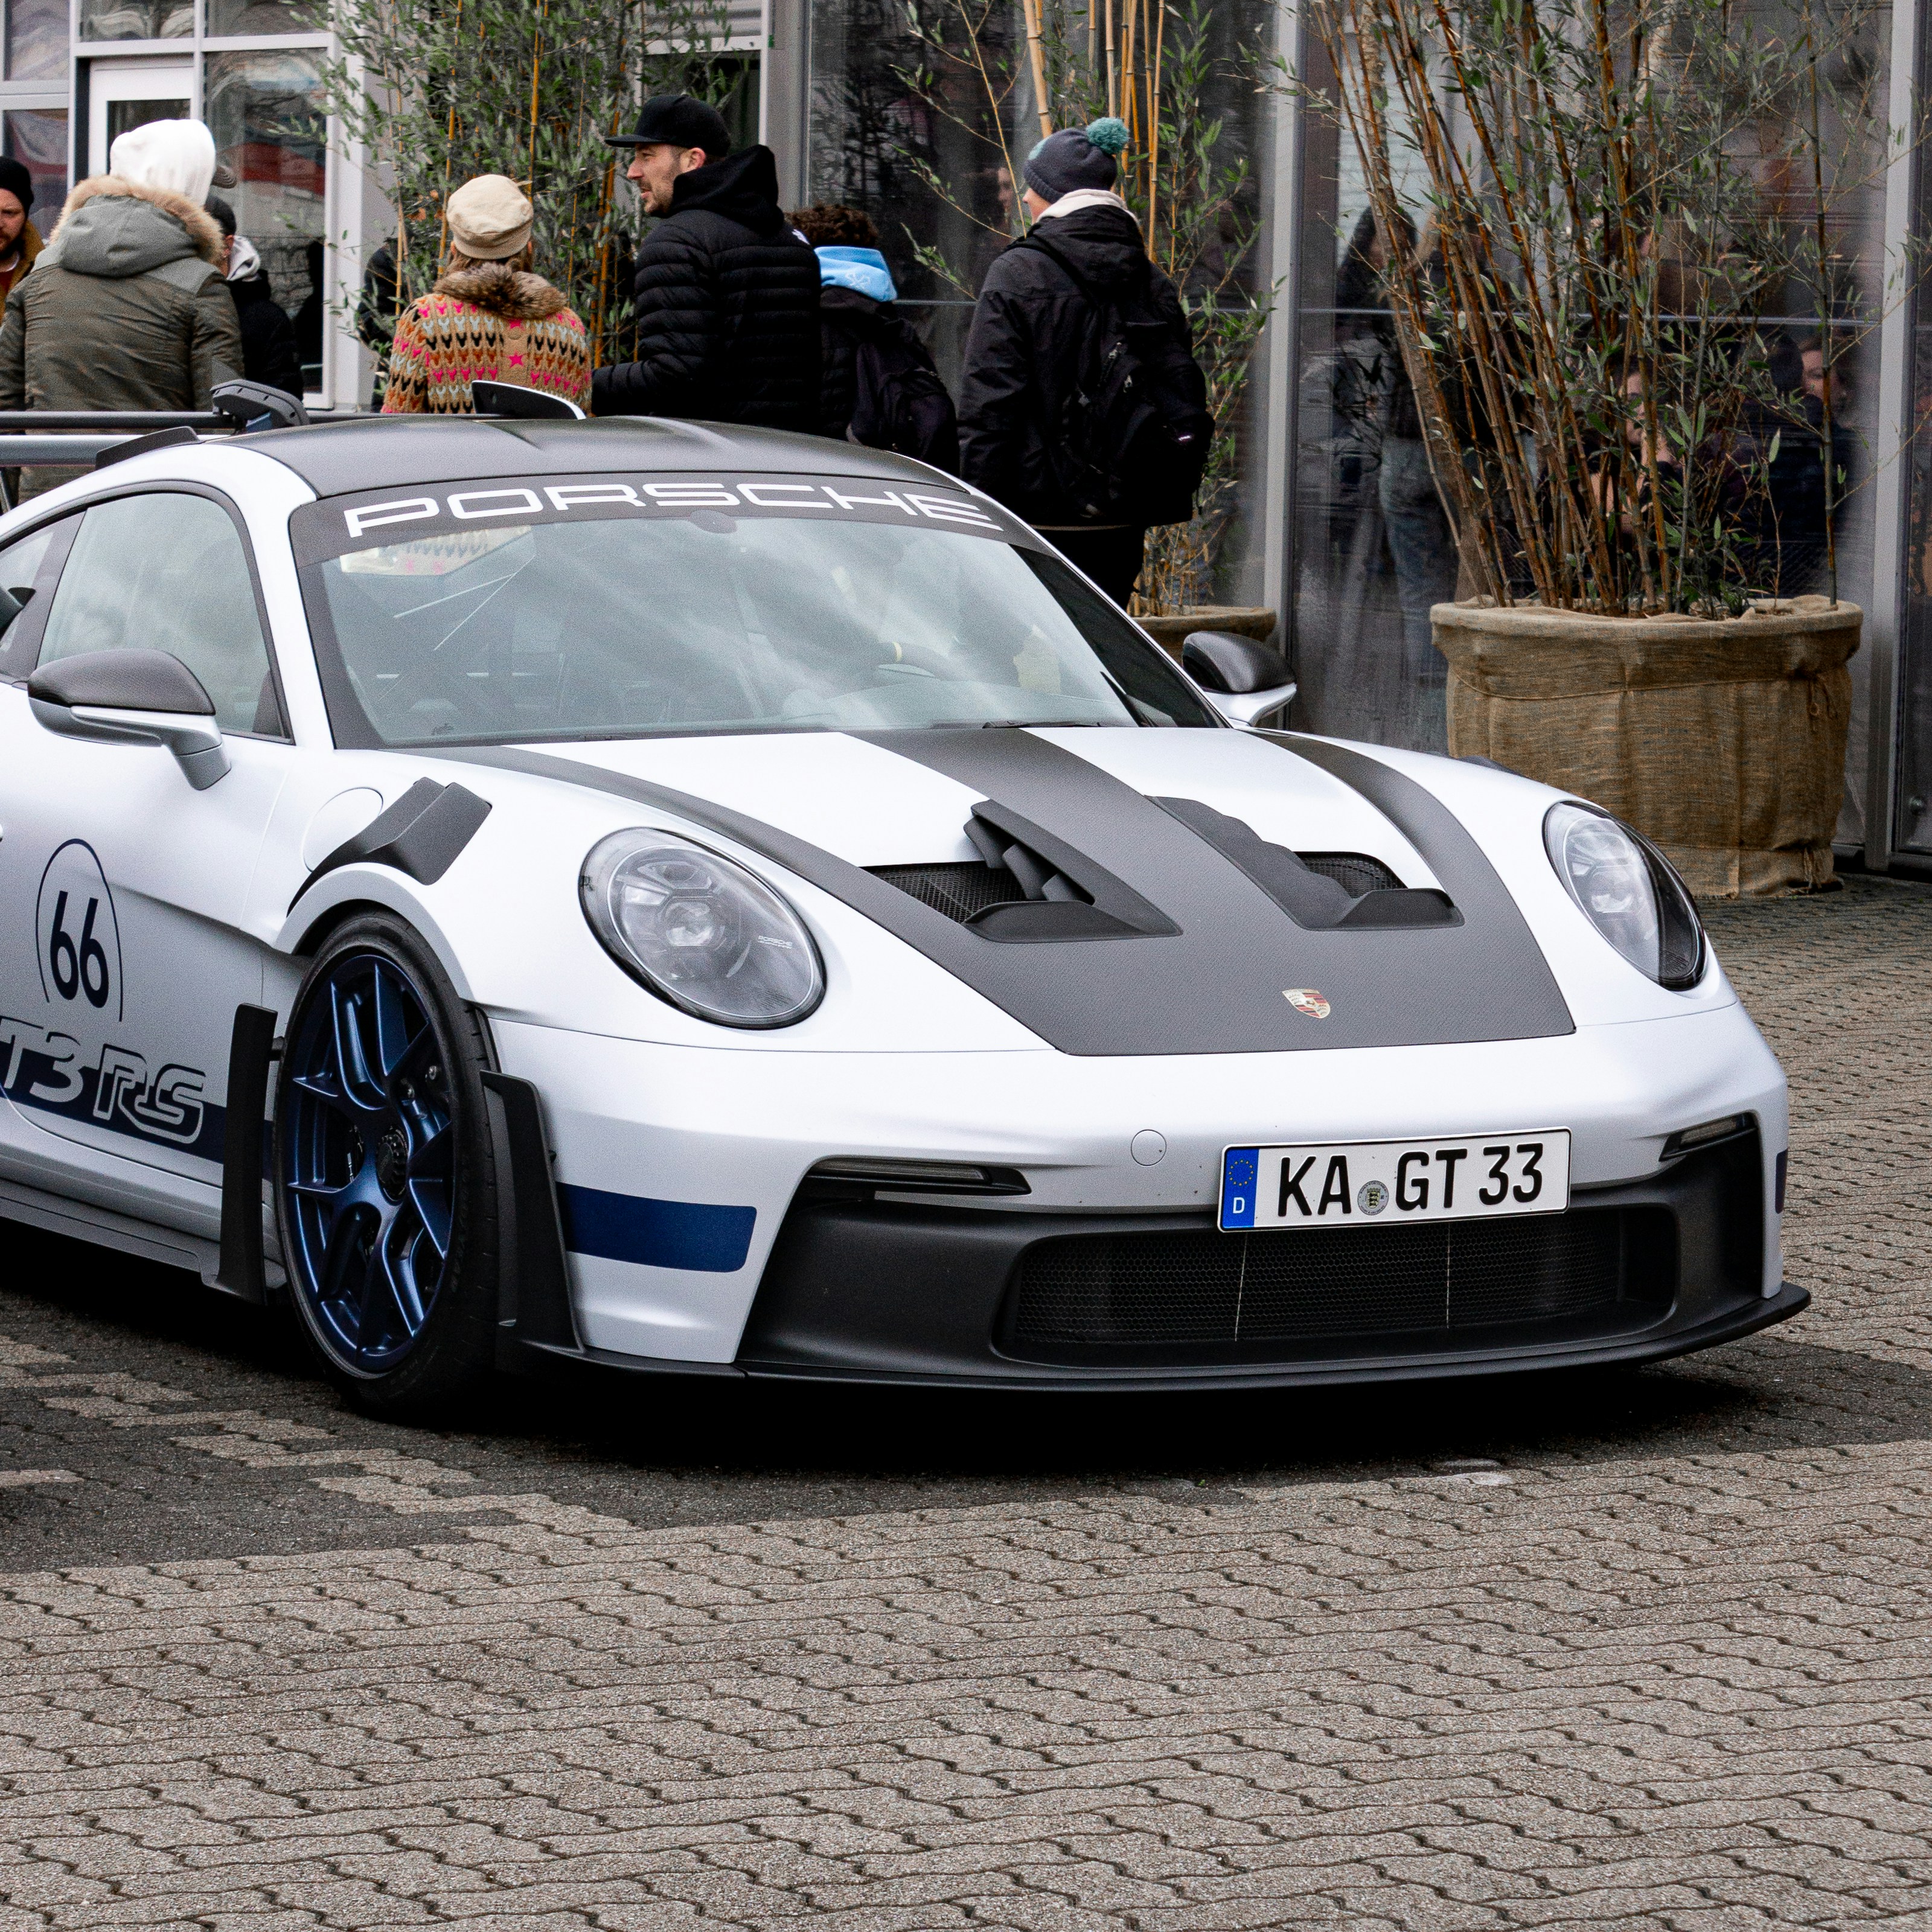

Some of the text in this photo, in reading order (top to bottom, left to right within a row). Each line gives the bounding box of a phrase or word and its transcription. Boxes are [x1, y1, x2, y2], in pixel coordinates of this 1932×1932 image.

[344, 483, 1003, 538] PORSCHE
[50, 891, 109, 1008] 66
[92, 1043, 206, 1144] RS
[1232, 1197, 1245, 1214] D
[1278, 1155, 1351, 1217] KA
[1395, 1148, 1468, 1211] GT
[1479, 1142, 1544, 1206] 33
